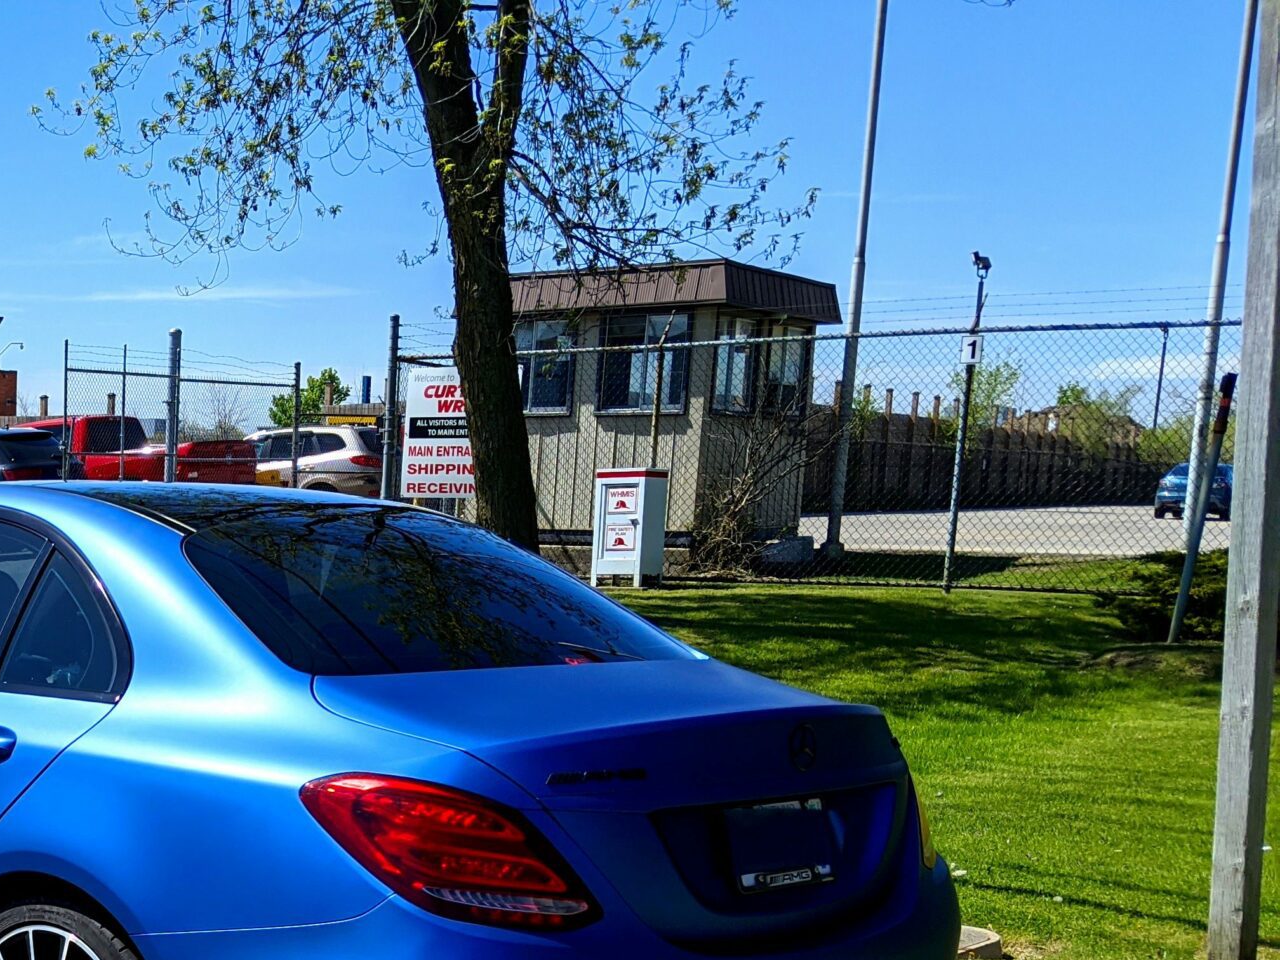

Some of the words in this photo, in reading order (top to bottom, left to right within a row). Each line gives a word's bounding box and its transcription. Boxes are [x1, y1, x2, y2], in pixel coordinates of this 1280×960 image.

[967, 340, 977, 359] 1
[414, 374, 446, 382] Welcome
[447, 374, 455, 382] to
[416, 419, 428, 427] ALL
[408, 446, 433, 457] MAIN
[436, 446, 473, 457] ENTRA
[610, 490, 635, 498] WHMIS
